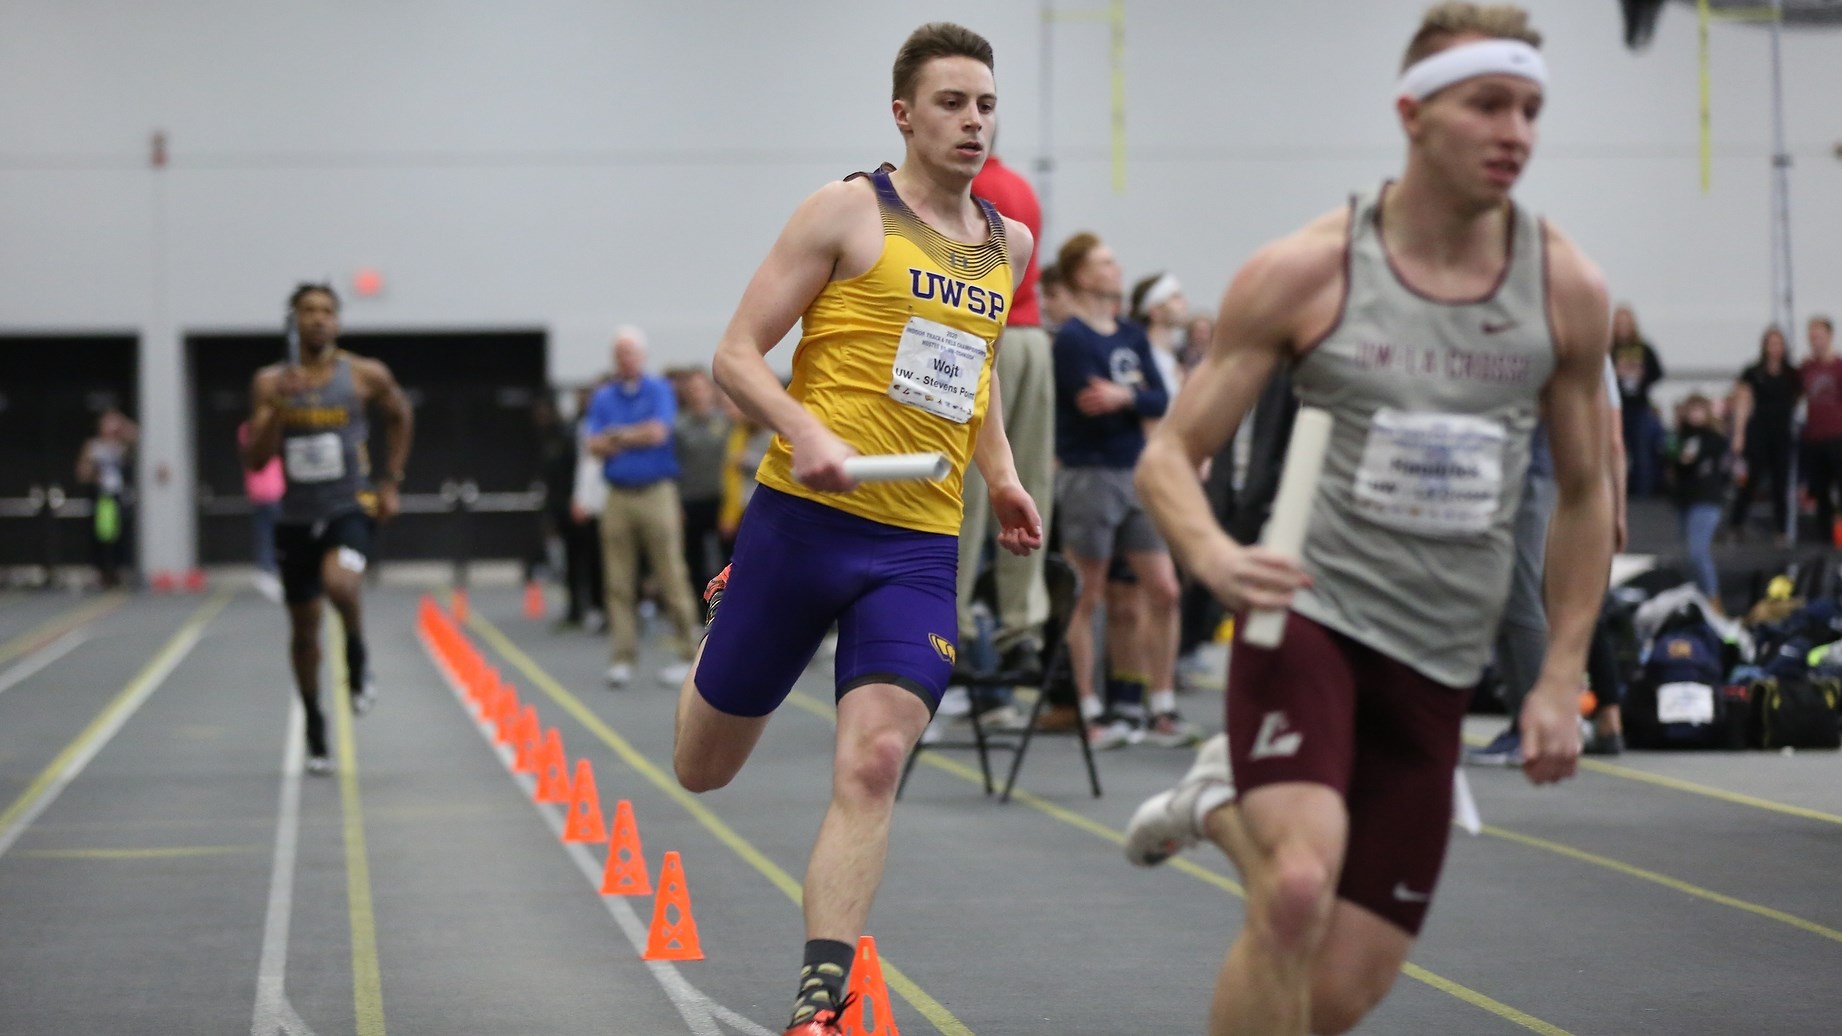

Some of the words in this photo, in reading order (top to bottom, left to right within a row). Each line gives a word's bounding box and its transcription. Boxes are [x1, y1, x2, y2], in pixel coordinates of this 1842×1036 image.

[908, 268, 1005, 321] UWSP
[926, 332, 941, 342] TRACK
[945, 339, 957, 347] FIELD
[933, 358, 960, 378] Wojt
[895, 367, 914, 380] UW
[922, 375, 958, 394] Stevens
